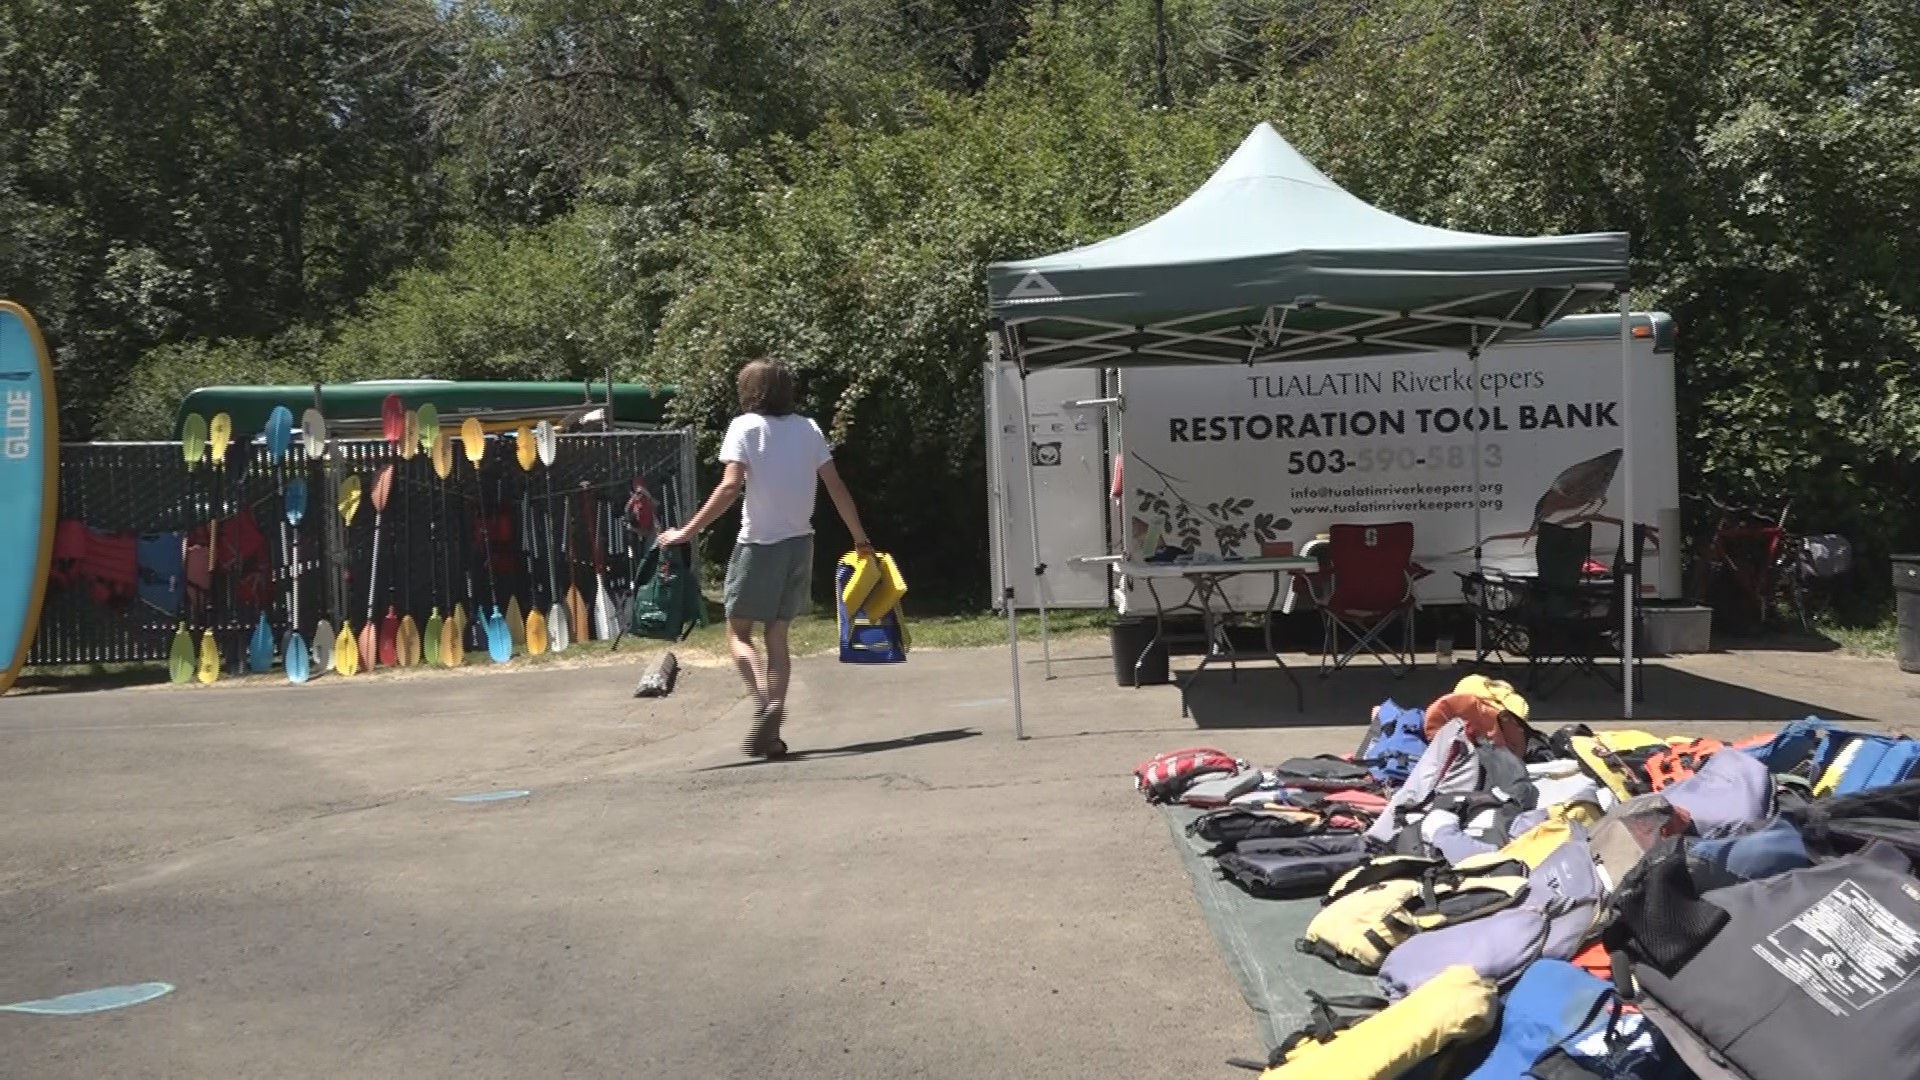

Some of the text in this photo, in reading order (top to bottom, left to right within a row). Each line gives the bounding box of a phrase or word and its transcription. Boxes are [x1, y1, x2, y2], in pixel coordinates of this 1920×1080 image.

[1246, 370, 1382, 398] TUALATIN
[5, 390, 31, 459] GLIDE
[1169, 401, 1620, 443] RESTORATION TOOL BANK
[1290, 482, 1504, 500] info@tualatinriverkeepersorg
[1290, 499, 1504, 515] www.tualatinriverkeepersorg
